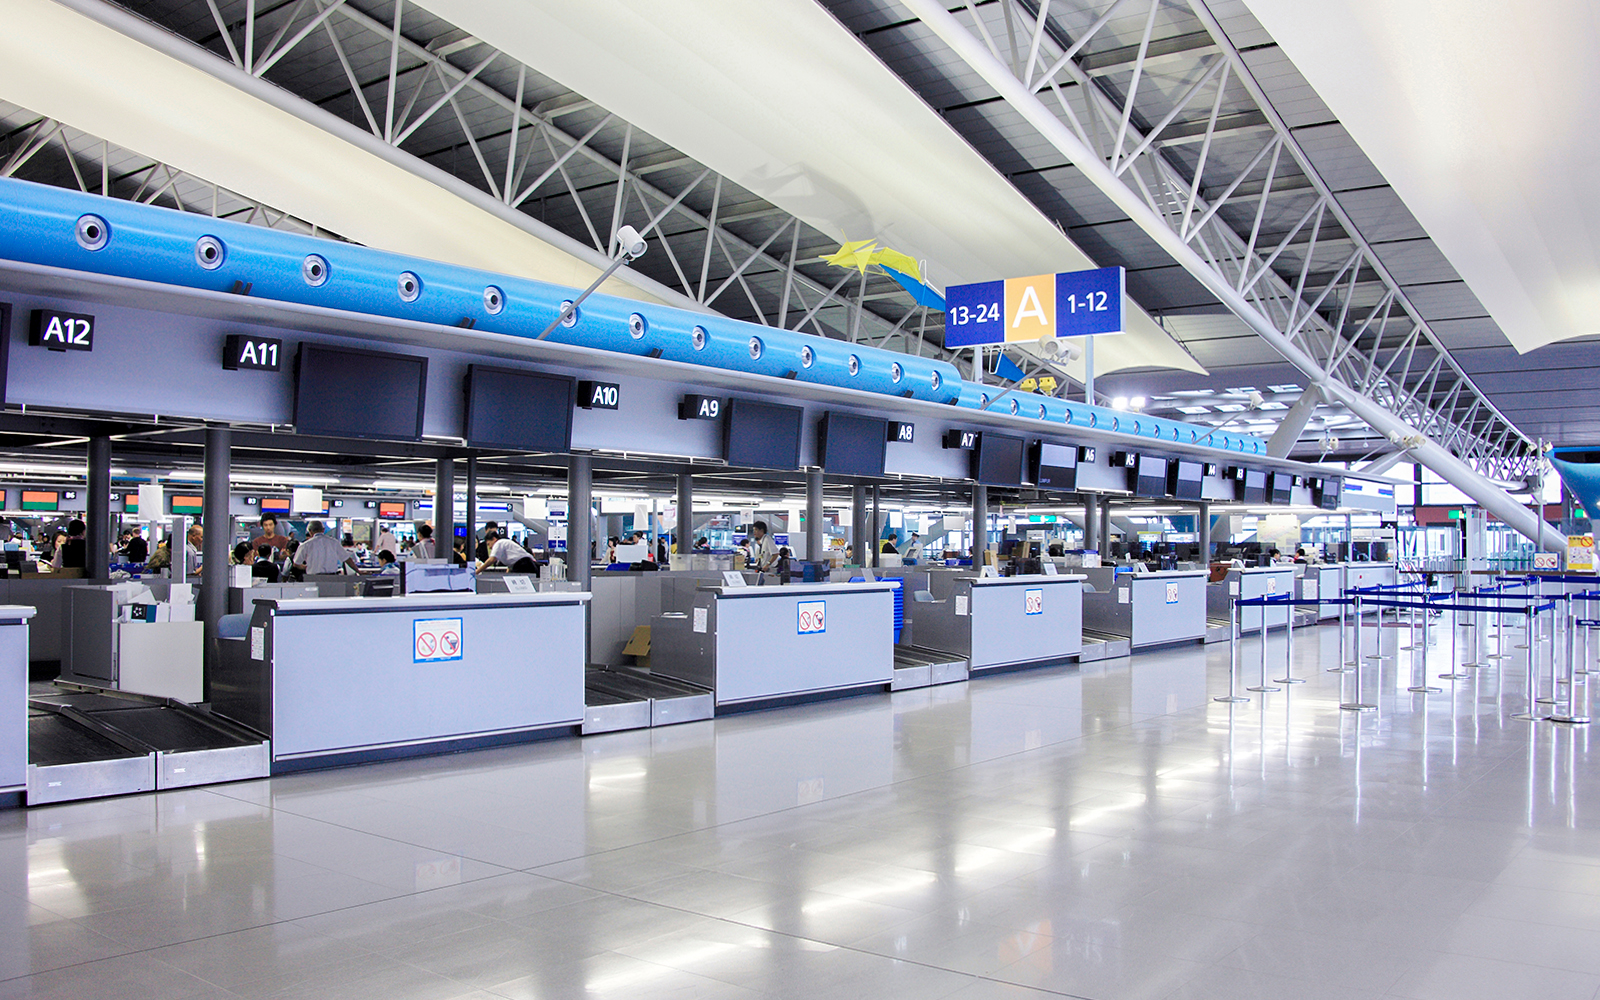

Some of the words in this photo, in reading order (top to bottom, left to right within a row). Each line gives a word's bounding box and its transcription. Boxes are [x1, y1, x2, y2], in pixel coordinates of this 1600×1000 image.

[949, 302, 1000, 326] 13-24
[1012, 285, 1048, 328] A
[1067, 291, 1108, 314] 1-12
[43, 316, 91, 346] A12
[239, 341, 278, 367] A11
[592, 385, 618, 406] A10
[699, 399, 719, 418] A9
[898, 424, 913, 441] A8
[961, 432, 974, 448] A7
[1085, 447, 1095, 462] A6
[1125, 453, 1135, 466] A5
[1208, 463, 1216, 476] A4
[1236, 467, 1244, 479] A3
